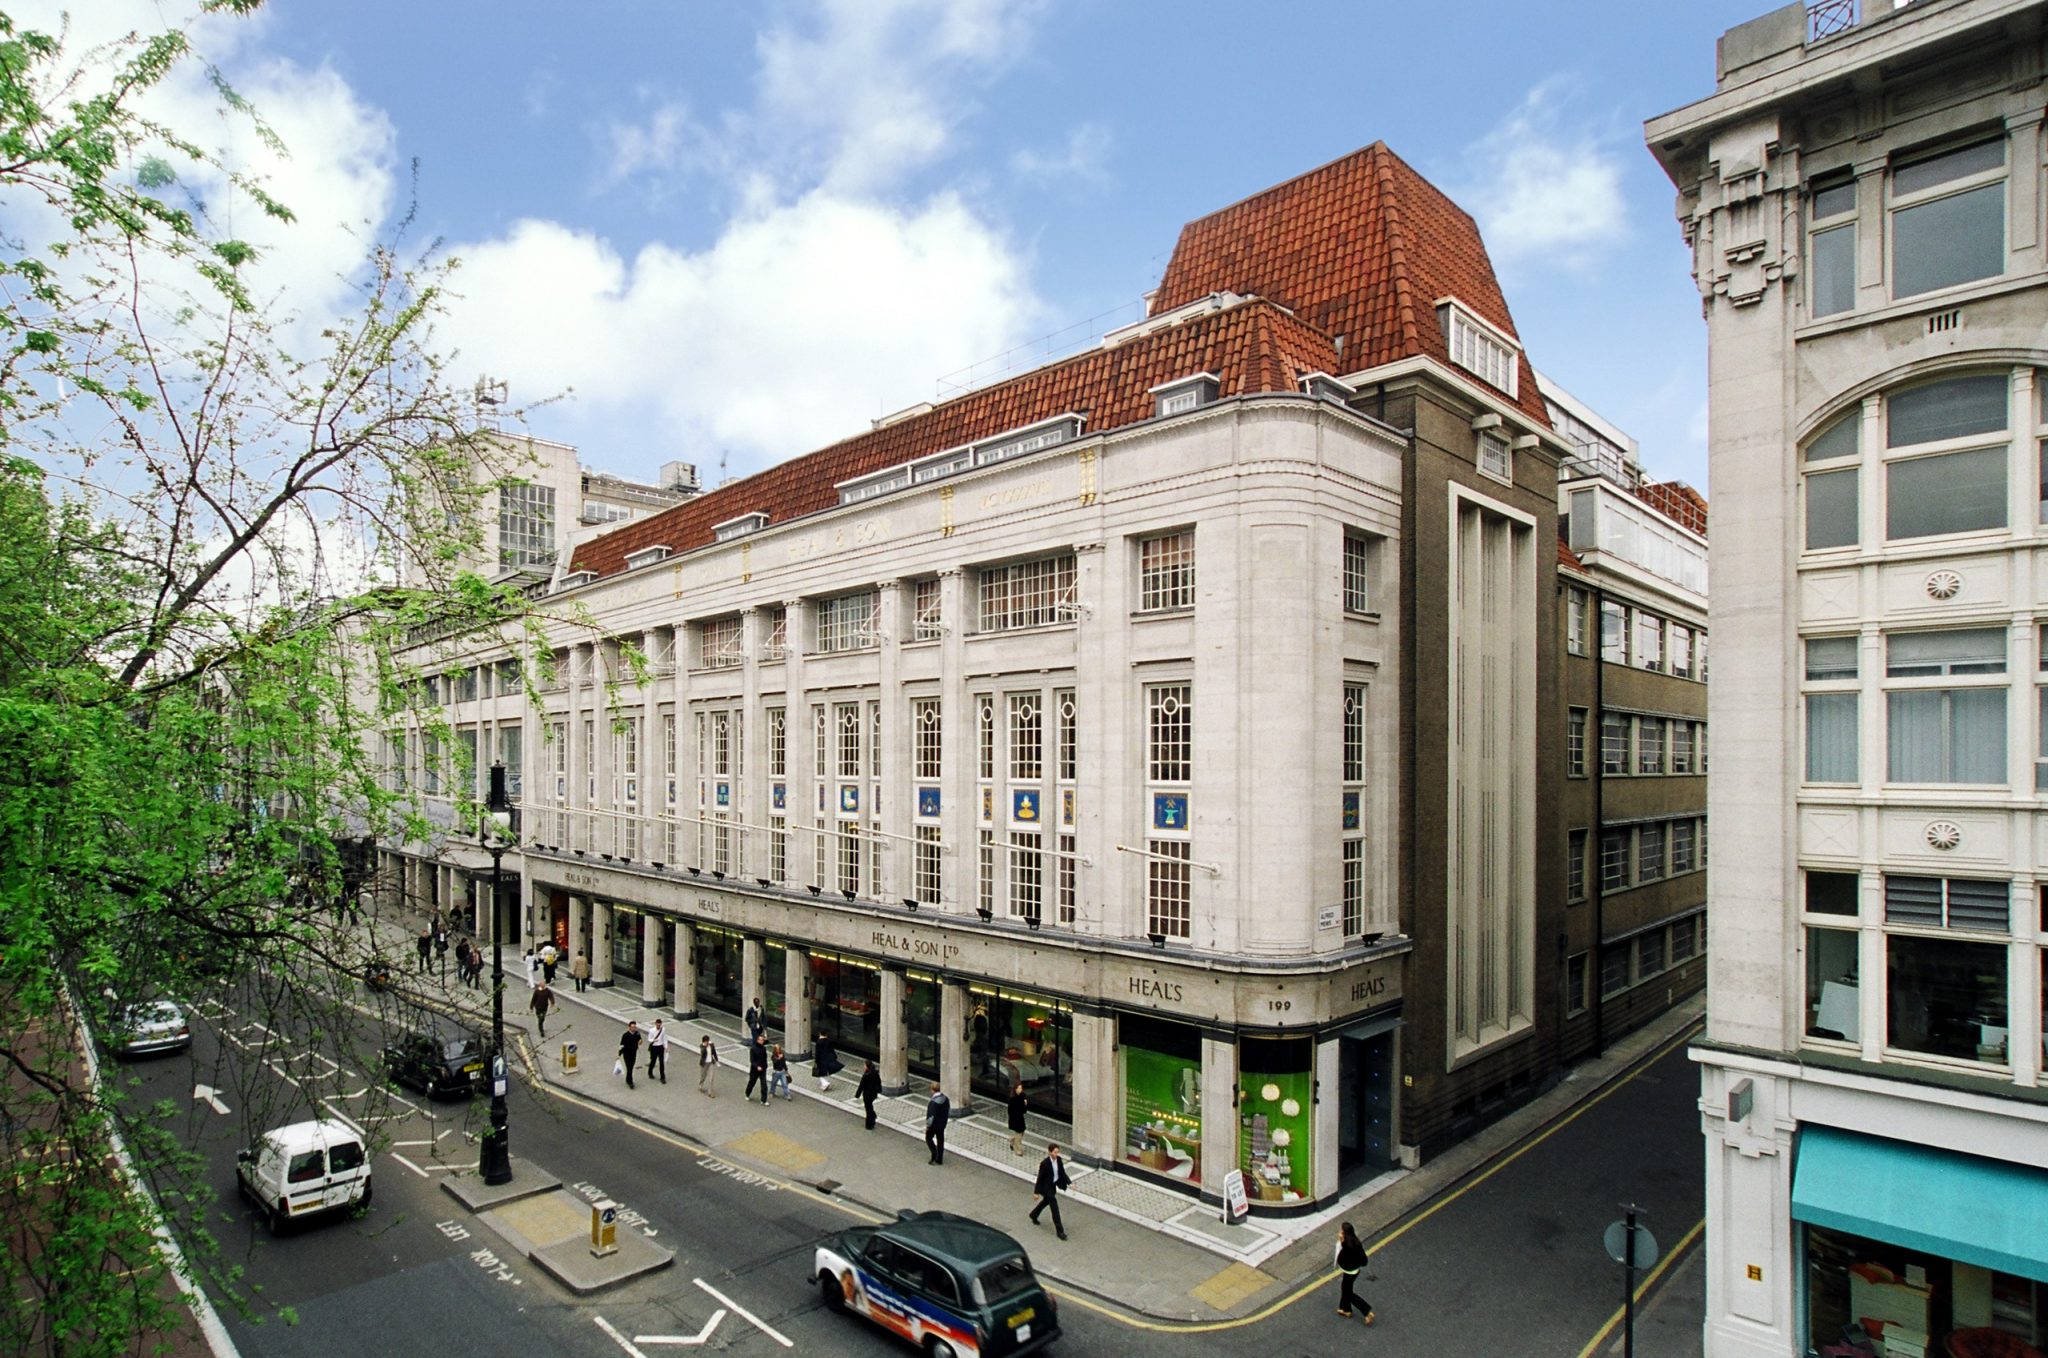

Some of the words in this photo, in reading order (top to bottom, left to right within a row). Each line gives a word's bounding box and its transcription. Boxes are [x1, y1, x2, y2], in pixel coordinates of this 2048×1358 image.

[872, 931, 898, 949] HEAL
[901, 937, 910, 951] &
[914, 939, 938, 956] SON
[1129, 976, 1182, 1001] HEAL'S
[1351, 977, 1385, 1001] HEAL'S
[1269, 1001, 1291, 1011] 199
[573, 1181, 608, 1201] LOOK
[436, 1220, 470, 1241] LEFT
[470, 1248, 509, 1274] LOOK
